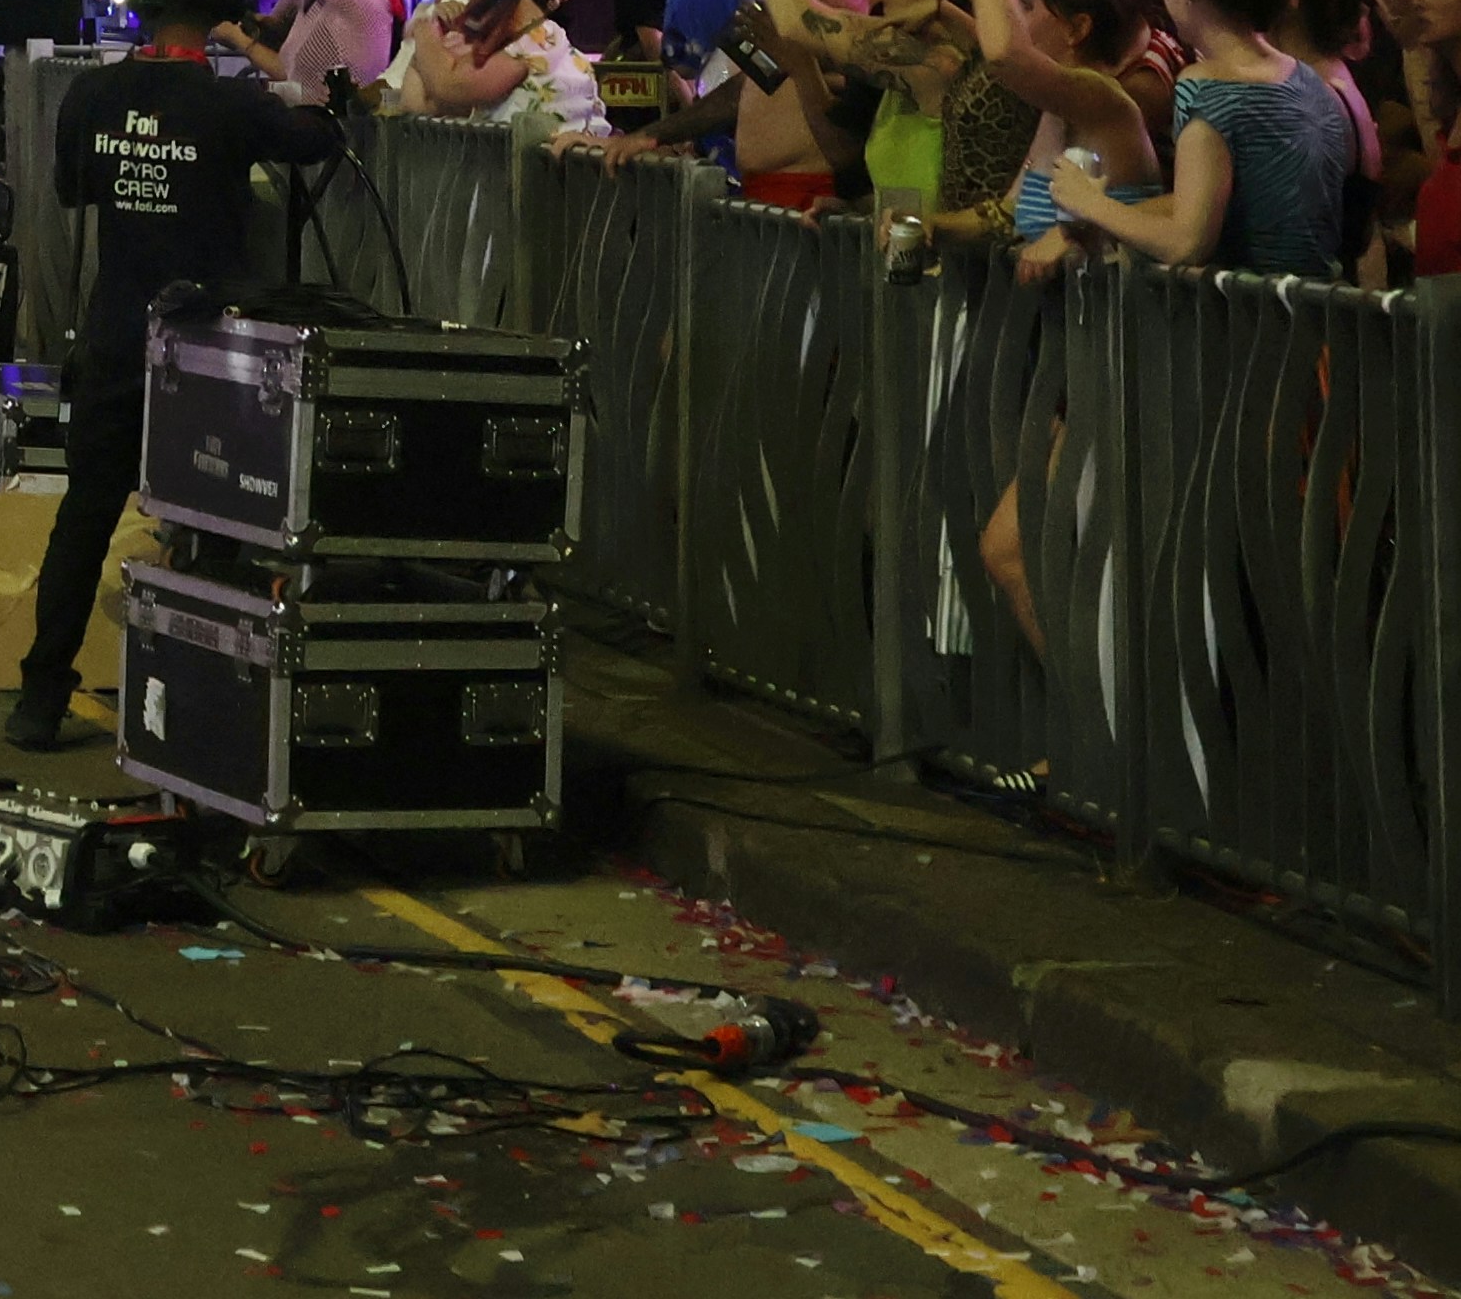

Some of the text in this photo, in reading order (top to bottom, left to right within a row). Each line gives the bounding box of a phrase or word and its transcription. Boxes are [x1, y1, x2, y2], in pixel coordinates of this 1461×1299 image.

[95, 133, 198, 161] Fireworks
[119, 160, 168, 181] PYRO
[114, 179, 170, 200] CREW
